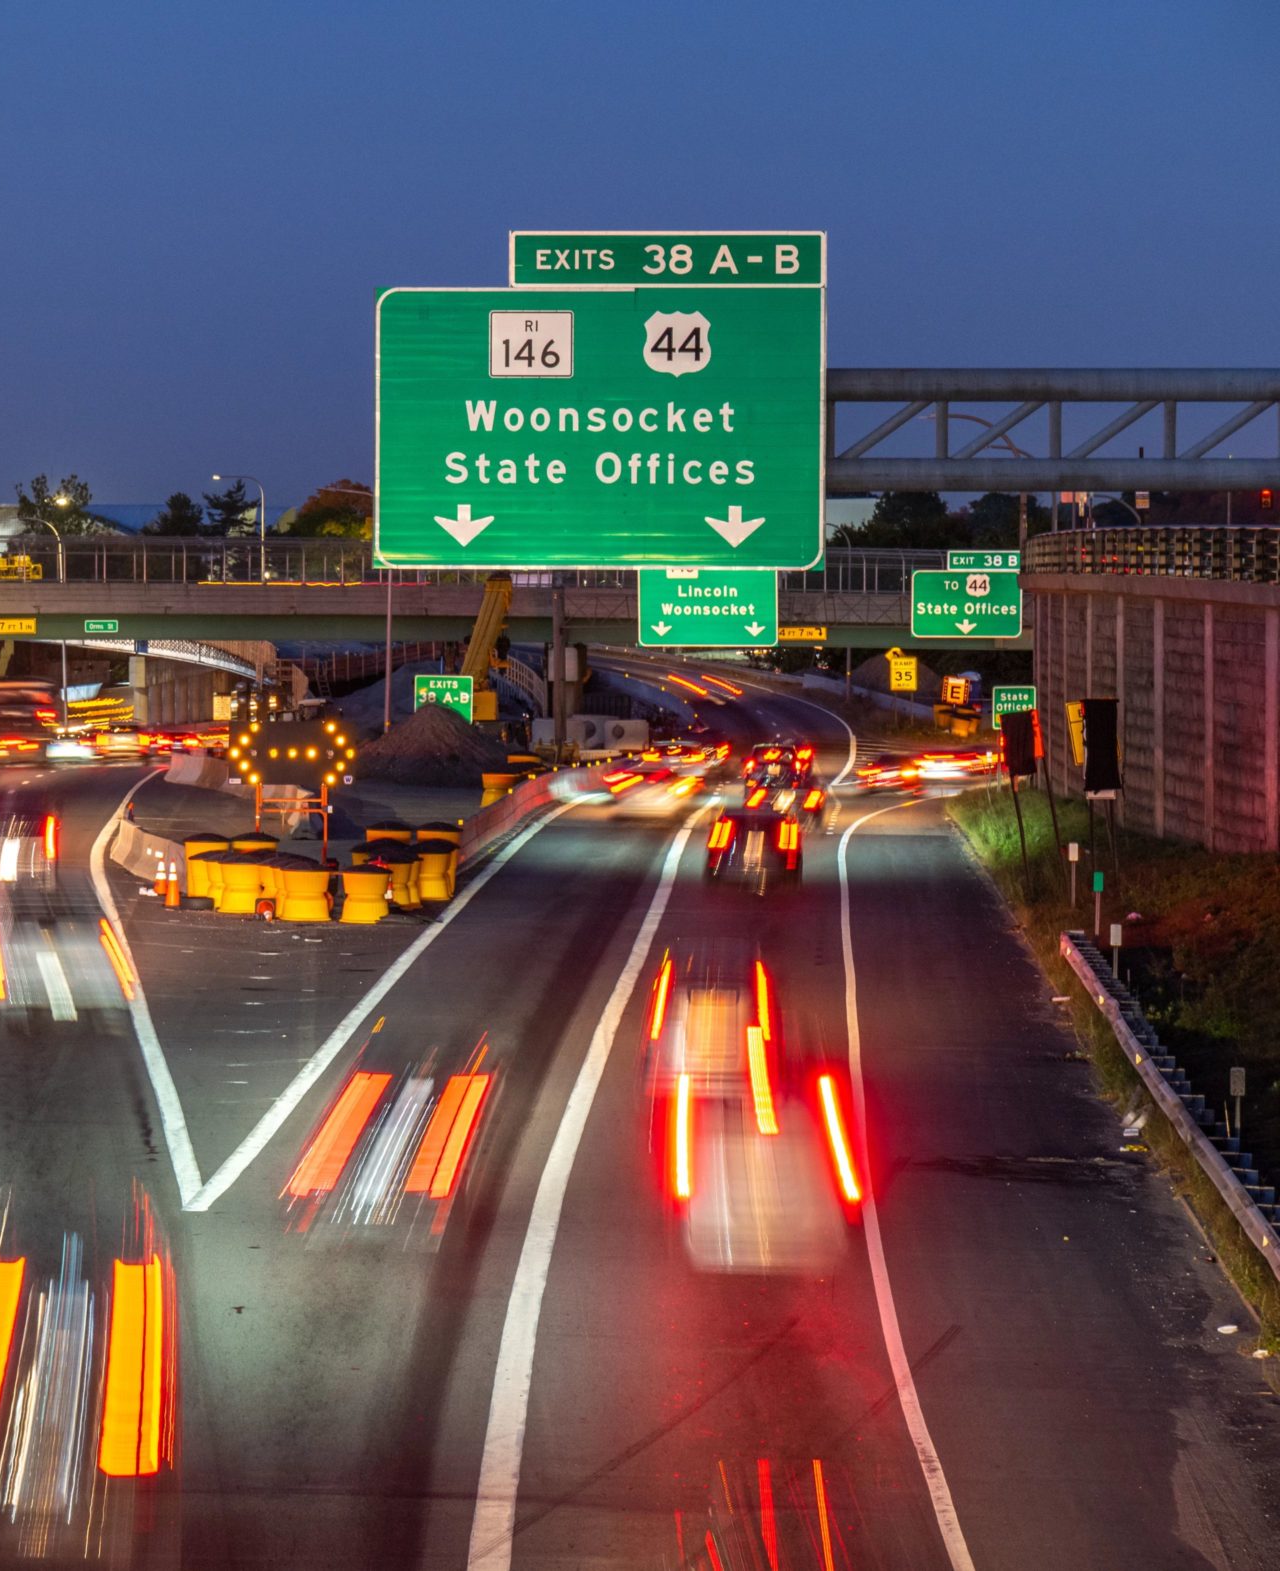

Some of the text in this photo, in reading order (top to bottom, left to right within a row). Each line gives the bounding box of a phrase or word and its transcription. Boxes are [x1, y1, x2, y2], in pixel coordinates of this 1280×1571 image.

[536, 249, 615, 271] EXITS
[642, 244, 693, 275] 38
[524, 319, 539, 333] RI
[650, 326, 704, 362] 44
[501, 338, 561, 369] 146
[465, 399, 735, 433] Woonsocket
[445, 451, 755, 486] State Offices
[952, 555, 1018, 567] EXIT 38 B
[677, 585, 738, 598] Lincoln
[944, 580, 959, 591] TO
[968, 579, 988, 592] 44
[661, 603, 755, 616] Woonsocket
[916, 602, 1017, 615] State Offices
[895, 671, 913, 682] 35
[429, 680, 459, 689] EXITS
[442, 691, 470, 704] A-B
[1000, 692, 1029, 702] State
